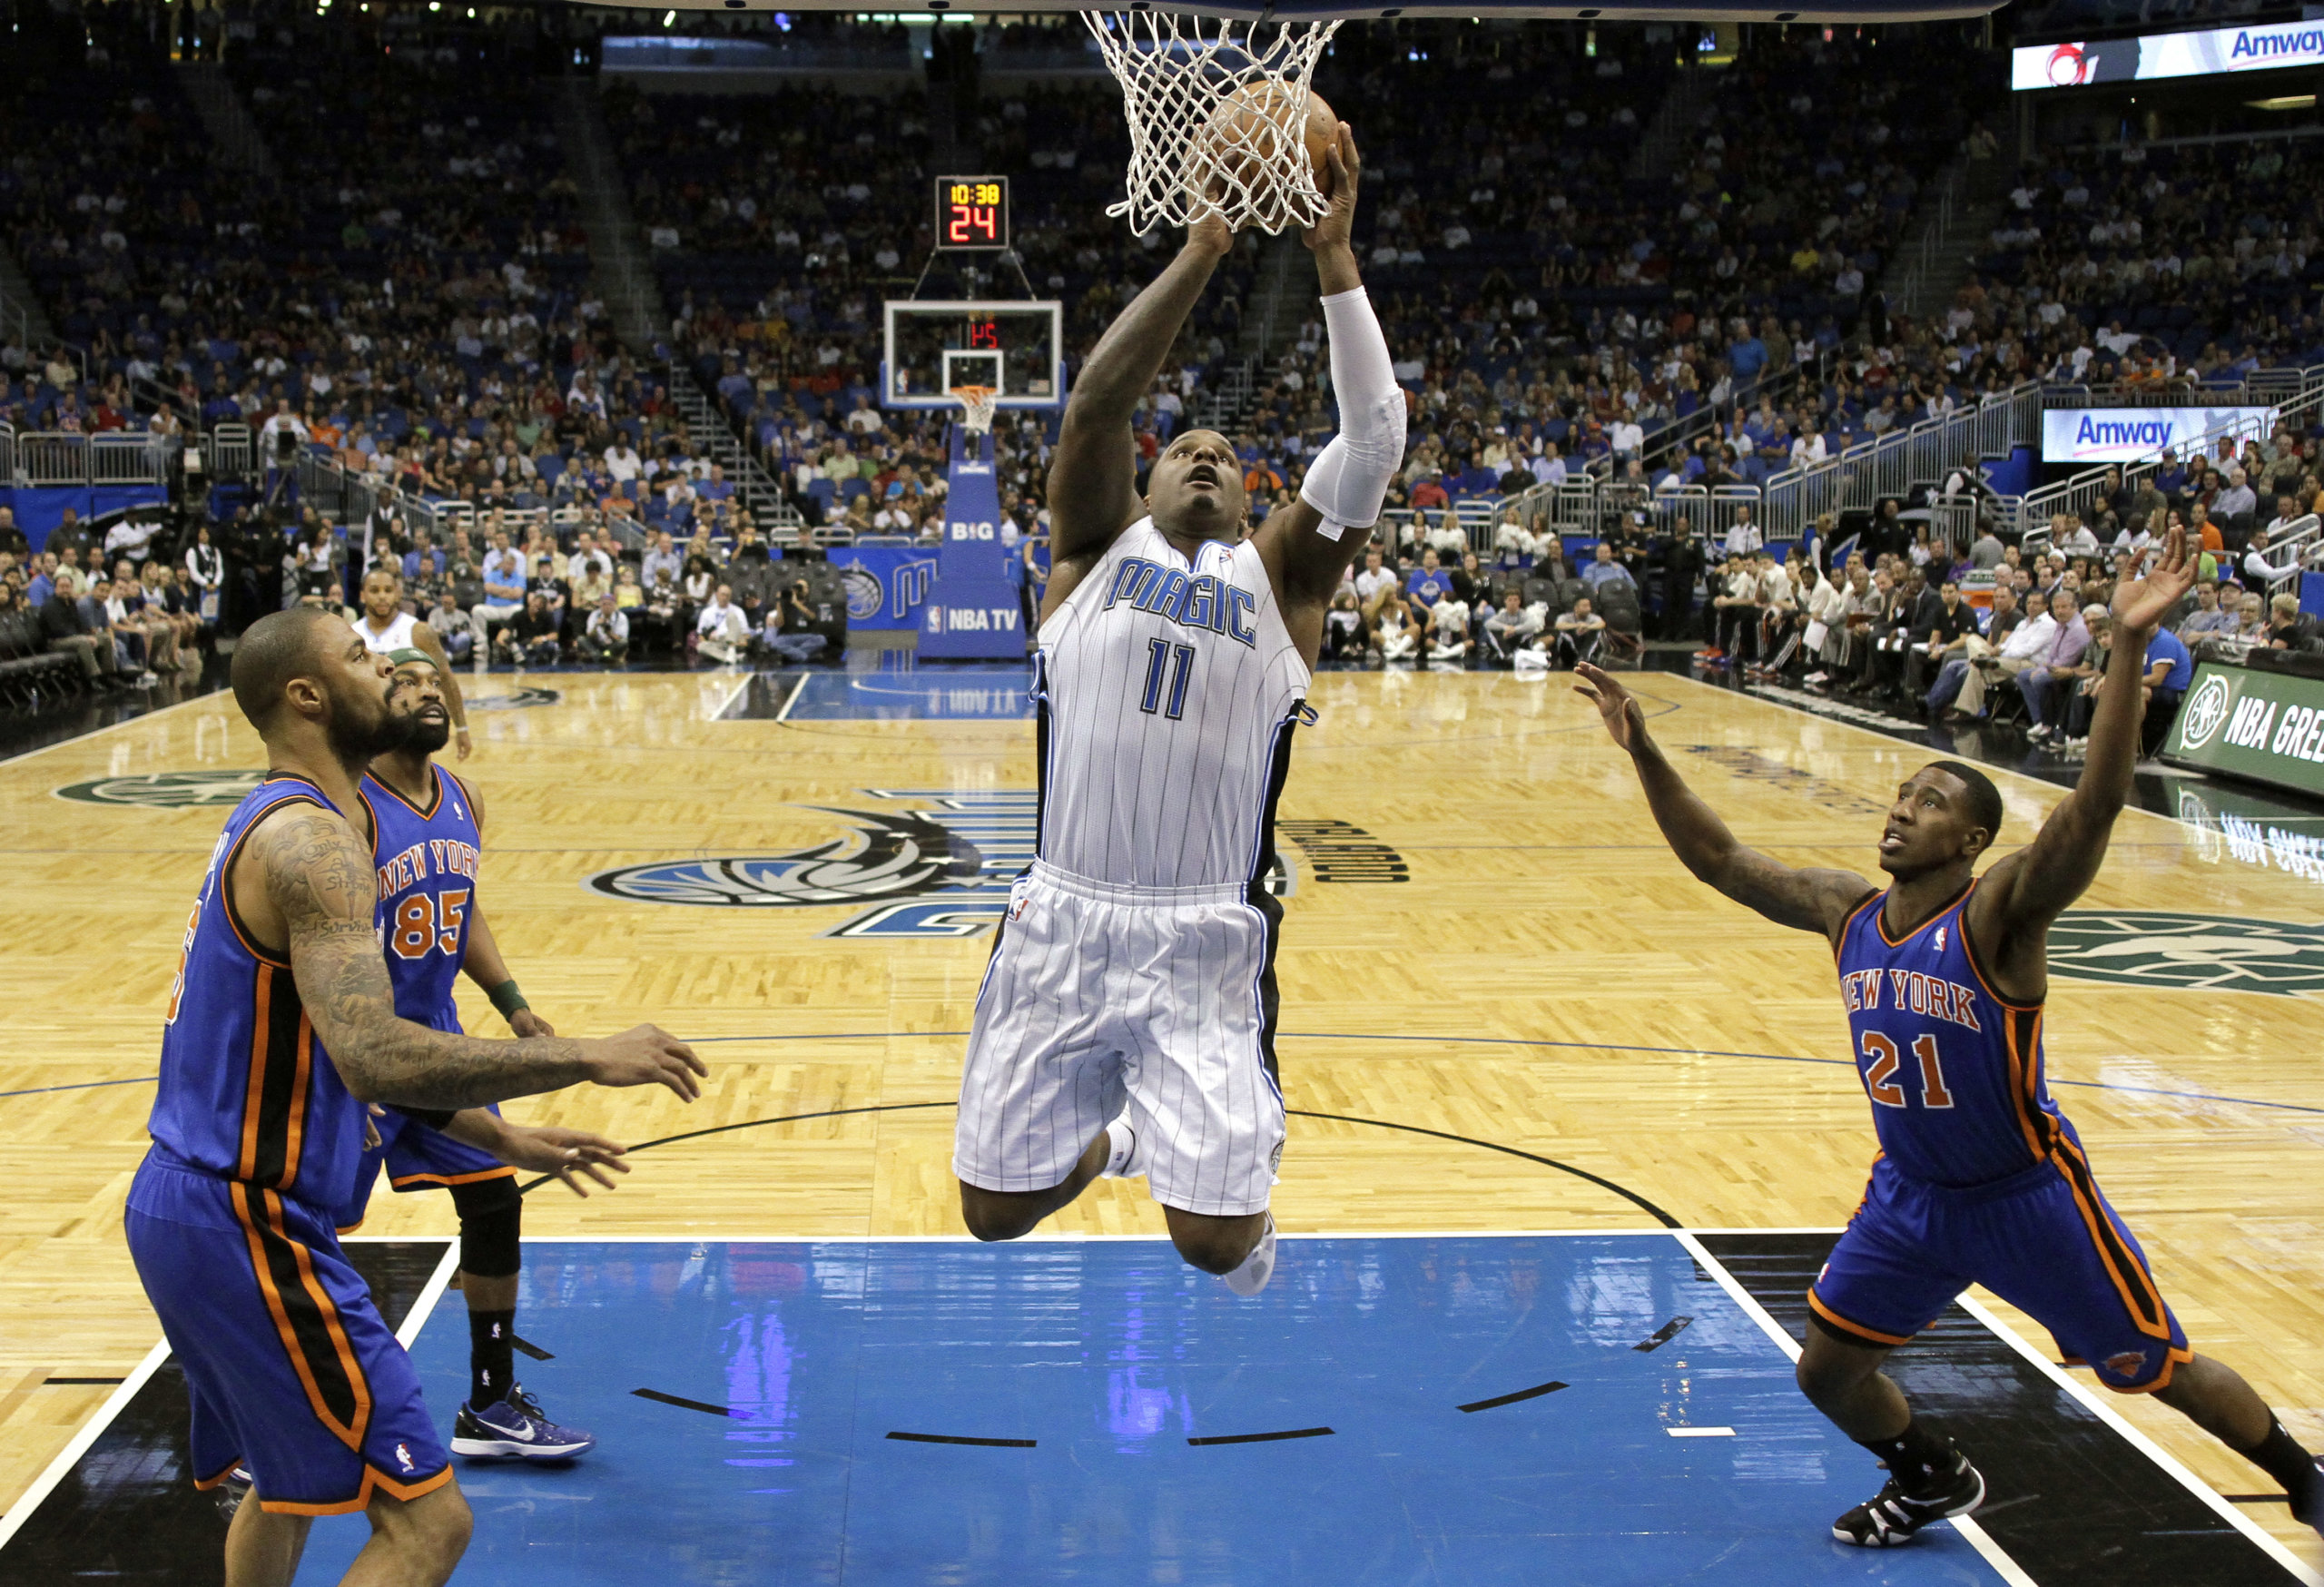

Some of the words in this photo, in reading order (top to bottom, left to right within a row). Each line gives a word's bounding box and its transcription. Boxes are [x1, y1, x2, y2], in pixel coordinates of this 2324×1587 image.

[2231, 31, 2324, 58] Amway
[950, 184, 1000, 204] 10:38
[950, 205, 995, 242] 24
[2076, 415, 2172, 447] Amway
[949, 609, 990, 630] NBA
[991, 609, 1018, 630] TV
[1104, 557, 1256, 650] MAGIC
[1140, 637, 1196, 721] 11
[2224, 695, 2277, 750] NBA
[378, 843, 427, 902] NEW
[391, 888, 470, 960] 85
[1889, 969, 1981, 1033] YORK
[1862, 1030, 1955, 1109] 21
